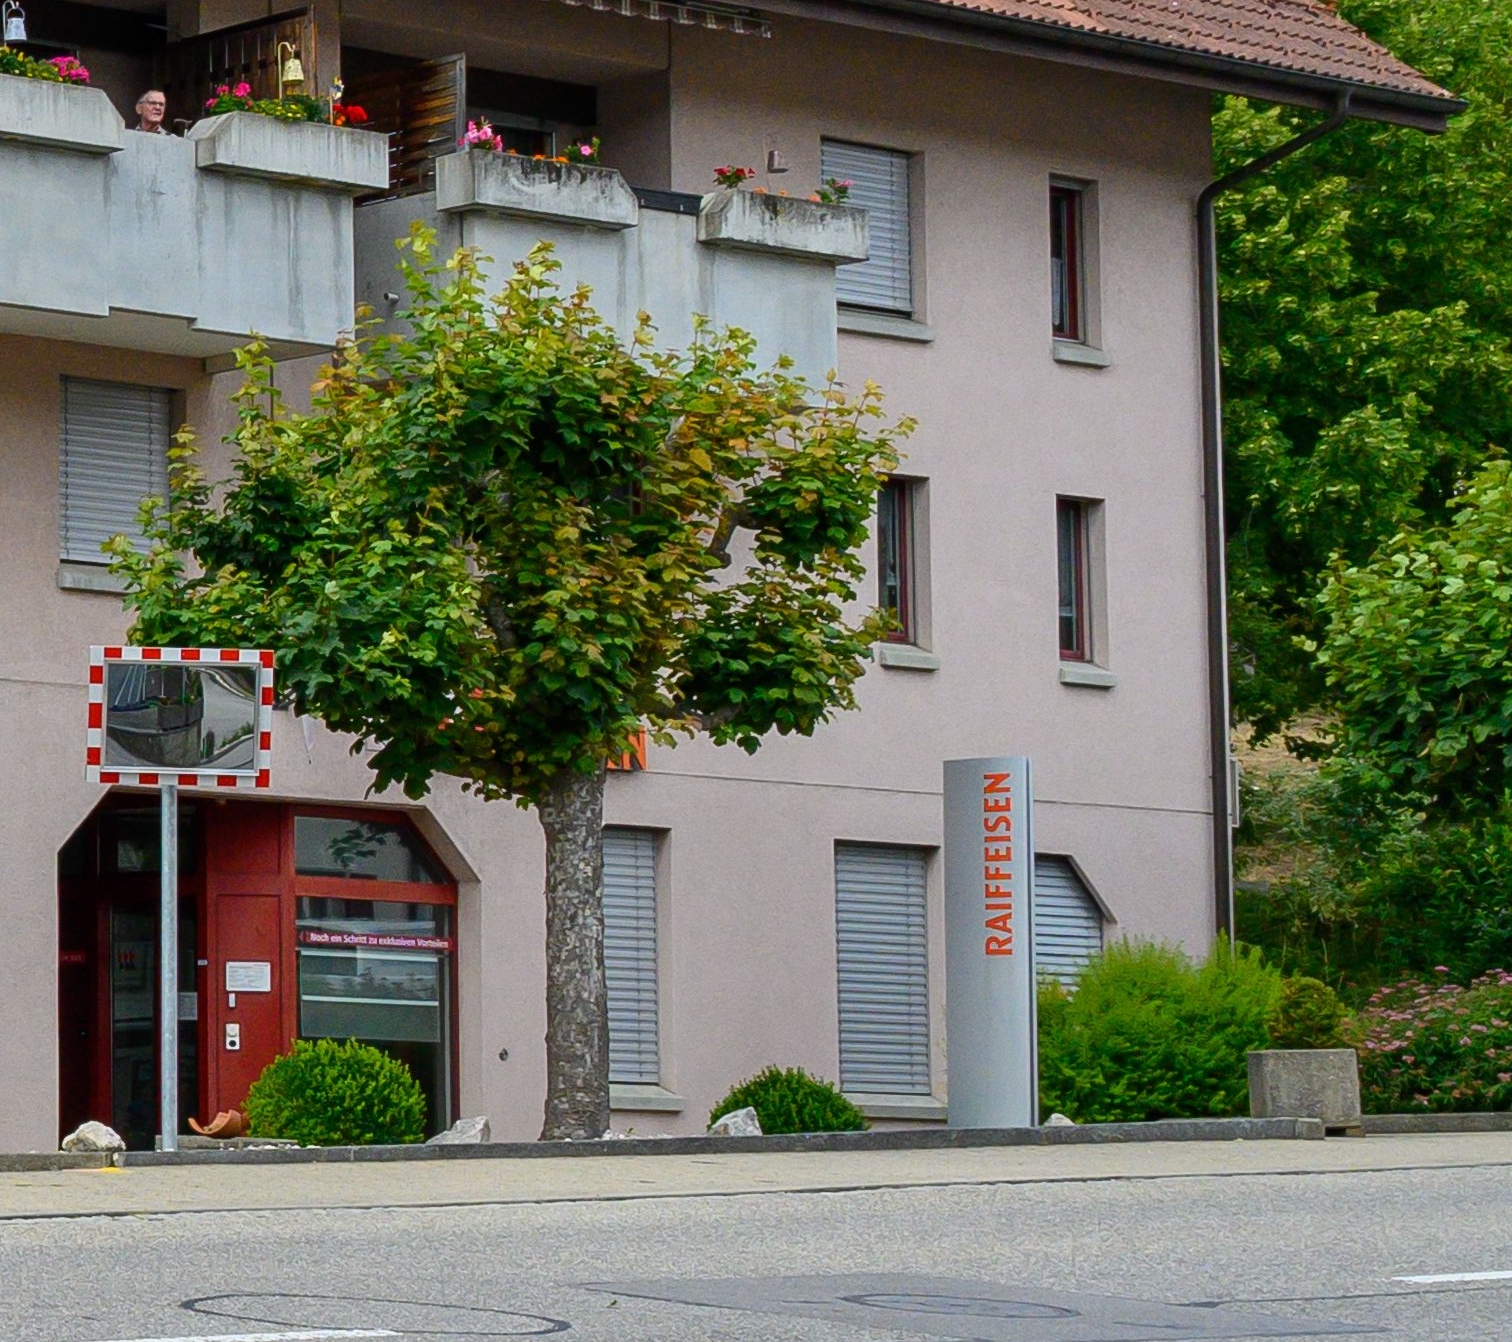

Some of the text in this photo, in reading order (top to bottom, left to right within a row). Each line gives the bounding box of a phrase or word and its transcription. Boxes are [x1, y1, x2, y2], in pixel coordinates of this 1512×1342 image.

[983, 772, 1013, 956] RAIFFEISEN
[310, 932, 329, 943] Noch
[331, 935, 342, 943] ein
[368, 936, 378, 944] zu
